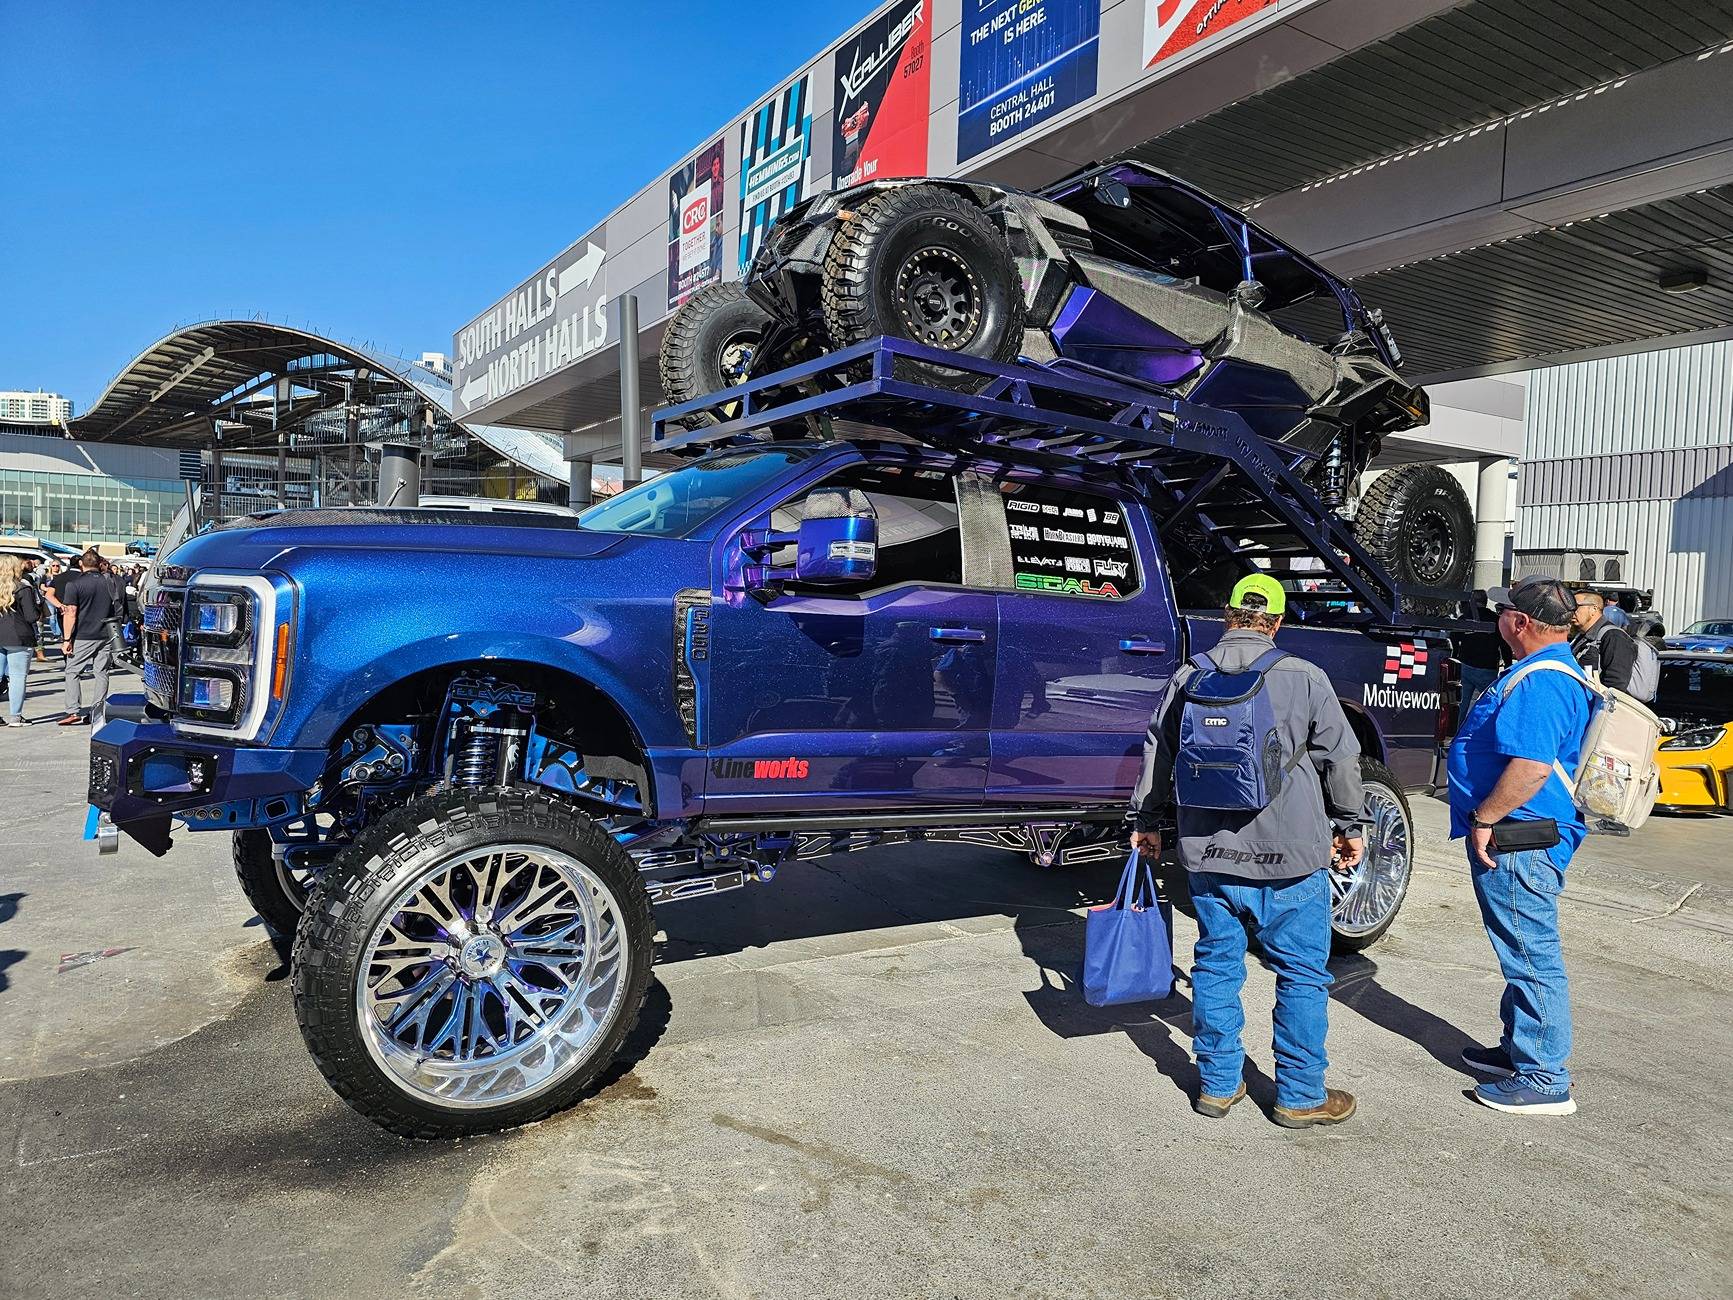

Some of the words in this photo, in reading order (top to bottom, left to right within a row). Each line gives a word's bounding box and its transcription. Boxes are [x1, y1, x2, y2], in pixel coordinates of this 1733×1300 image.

[970, 23, 990, 46] THE
[991, 4, 1018, 34] NEXT
[1003, 27, 1014, 45] IS
[1015, 7, 1047, 38] HERE.
[989, 108, 1023, 136] BOOTH
[1024, 90, 1056, 118] 24401
[990, 92, 1029, 119] CENTRAL
[1030, 76, 1055, 99] HALL
[863, 159, 879, 177] Your
[683, 201, 707, 230] CRC
[459, 308, 502, 370] SOUTH
[505, 267, 557, 343] HALLS
[487, 335, 540, 401] NORTH
[544, 294, 608, 374] HALLS
[1007, 500, 1040, 512] RIGID
[1093, 558, 1128, 579] FURY
